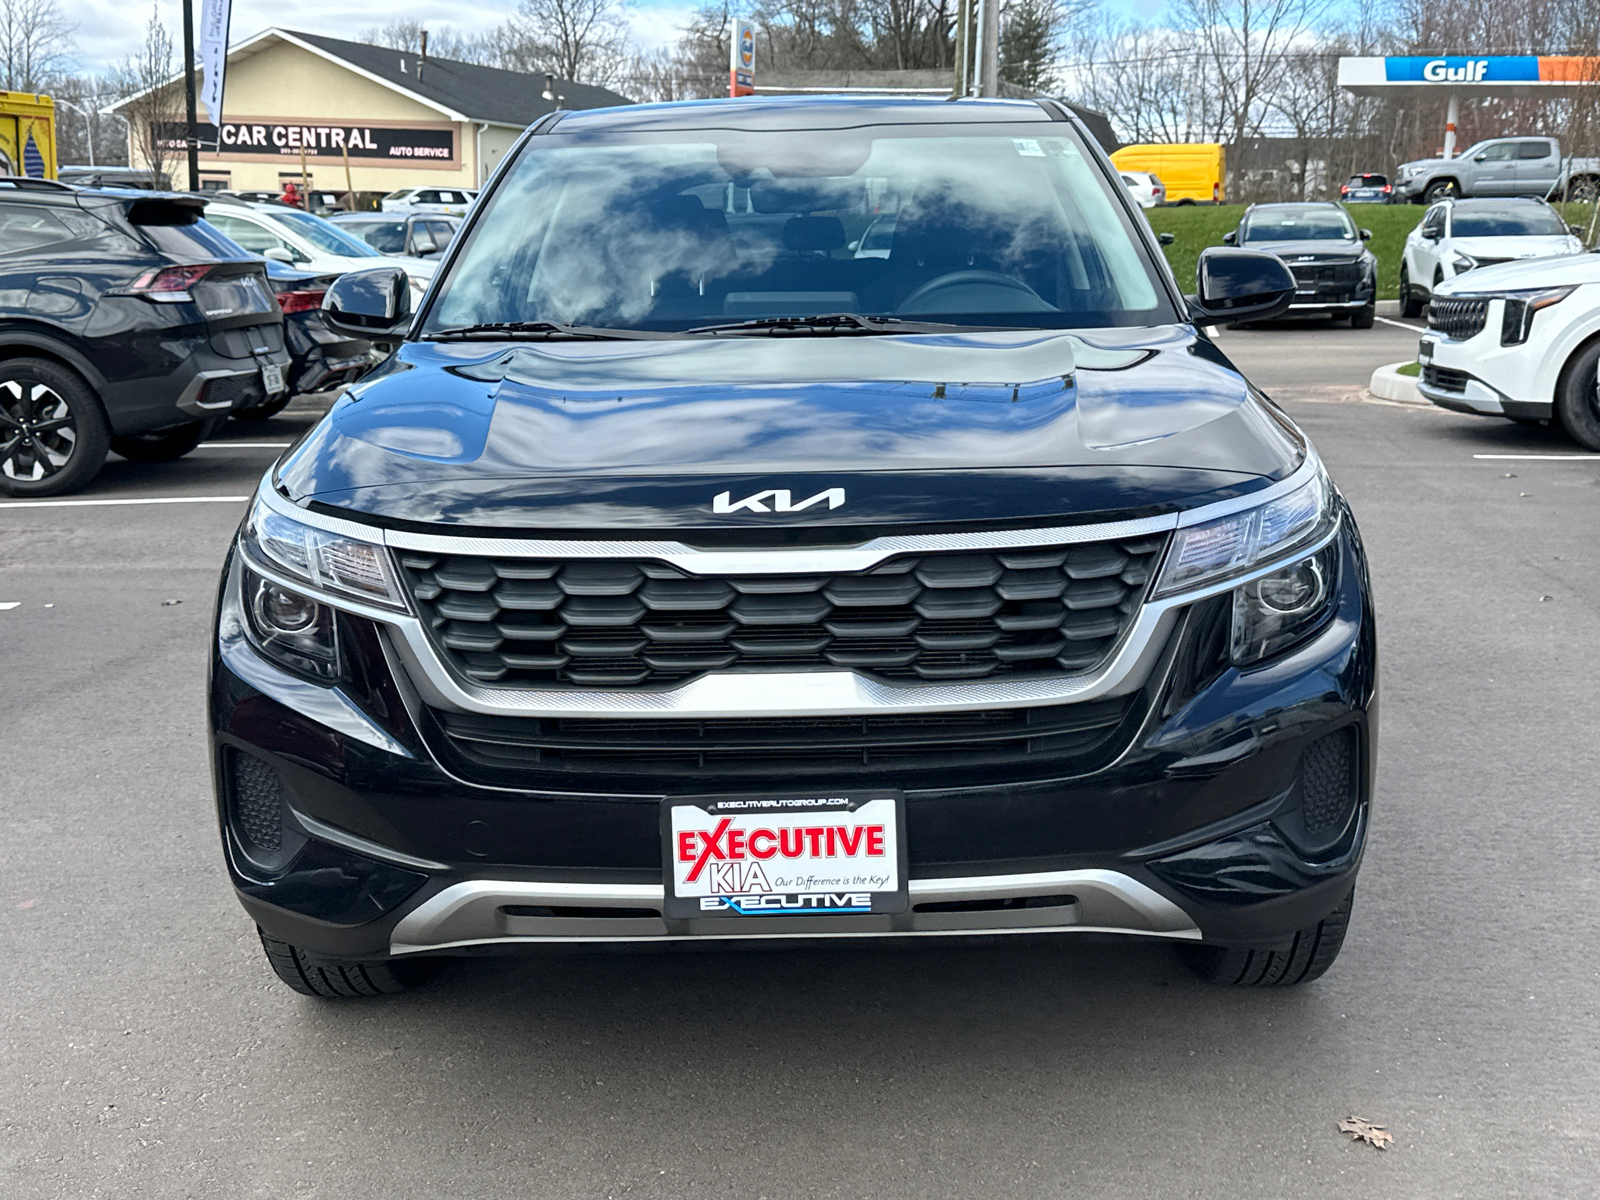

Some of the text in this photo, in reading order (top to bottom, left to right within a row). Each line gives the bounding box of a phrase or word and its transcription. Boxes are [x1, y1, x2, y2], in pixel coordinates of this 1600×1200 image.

[1423, 59, 1489, 82] Gulf
[221, 125, 378, 149] CAR CENTRAL
[389, 146, 450, 158] AUTO SERVICE
[712, 487, 846, 514] KIA
[717, 798, 849, 809] EXECUTIVEAUTOGROUP.COM
[677, 816, 886, 884] EXECUTIVE
[710, 862, 773, 894] KIA
[775, 874, 890, 891] Our Difference is the Key!
[700, 893, 872, 913] EXECUTIVE
